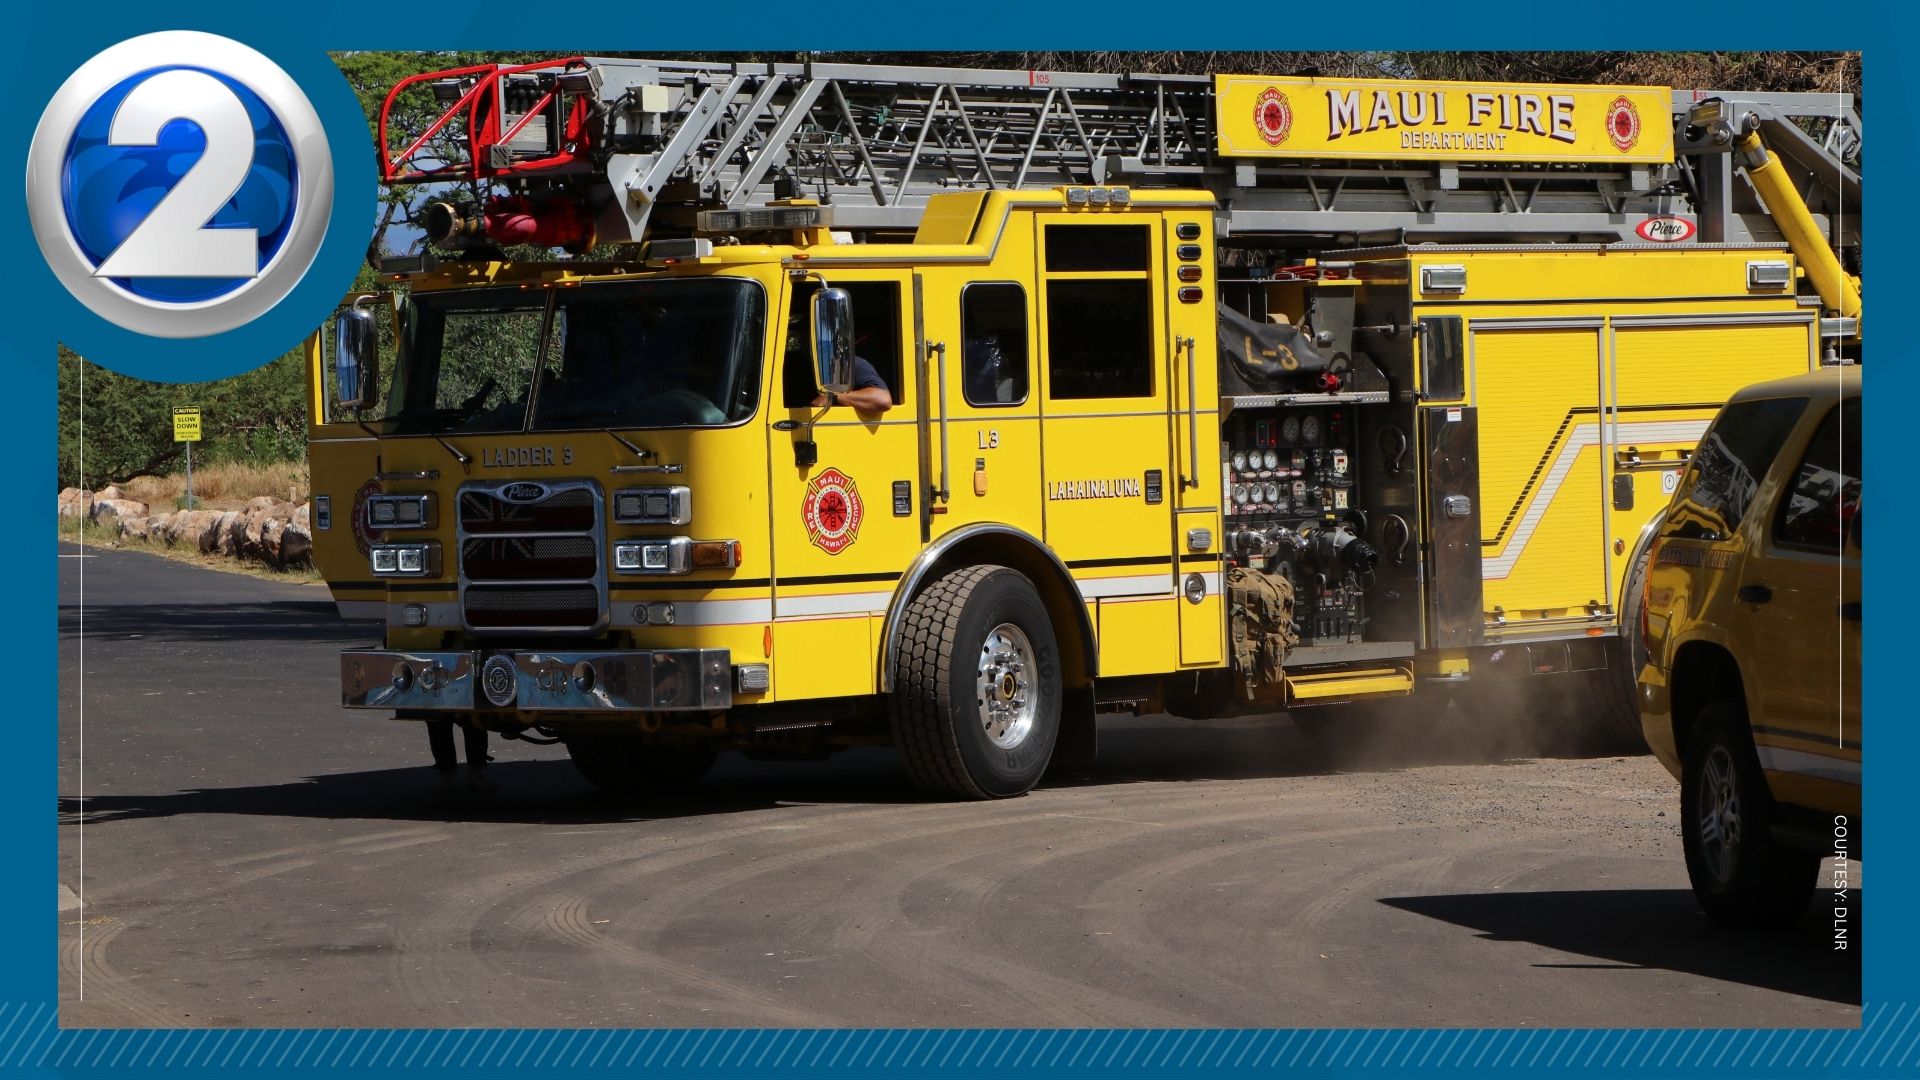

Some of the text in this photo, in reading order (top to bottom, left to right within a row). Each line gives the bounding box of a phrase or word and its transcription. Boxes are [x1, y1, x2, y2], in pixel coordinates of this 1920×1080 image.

[1325, 88, 1449, 141] MAUI
[1466, 92, 1577, 144] FIRE
[1400, 130, 1506, 150] DEPARTMENT
[1650, 220, 1682, 236] Pierce
[1243, 335, 1298, 371] L-3
[978, 429, 999, 450] L3
[482, 444, 573, 467] LADDER 3
[508, 485, 539, 498] Pierce
[820, 476, 844, 487] MAUI
[1049, 478, 1141, 501] LAHAINALUNA
[807, 494, 816, 530] FIRE
